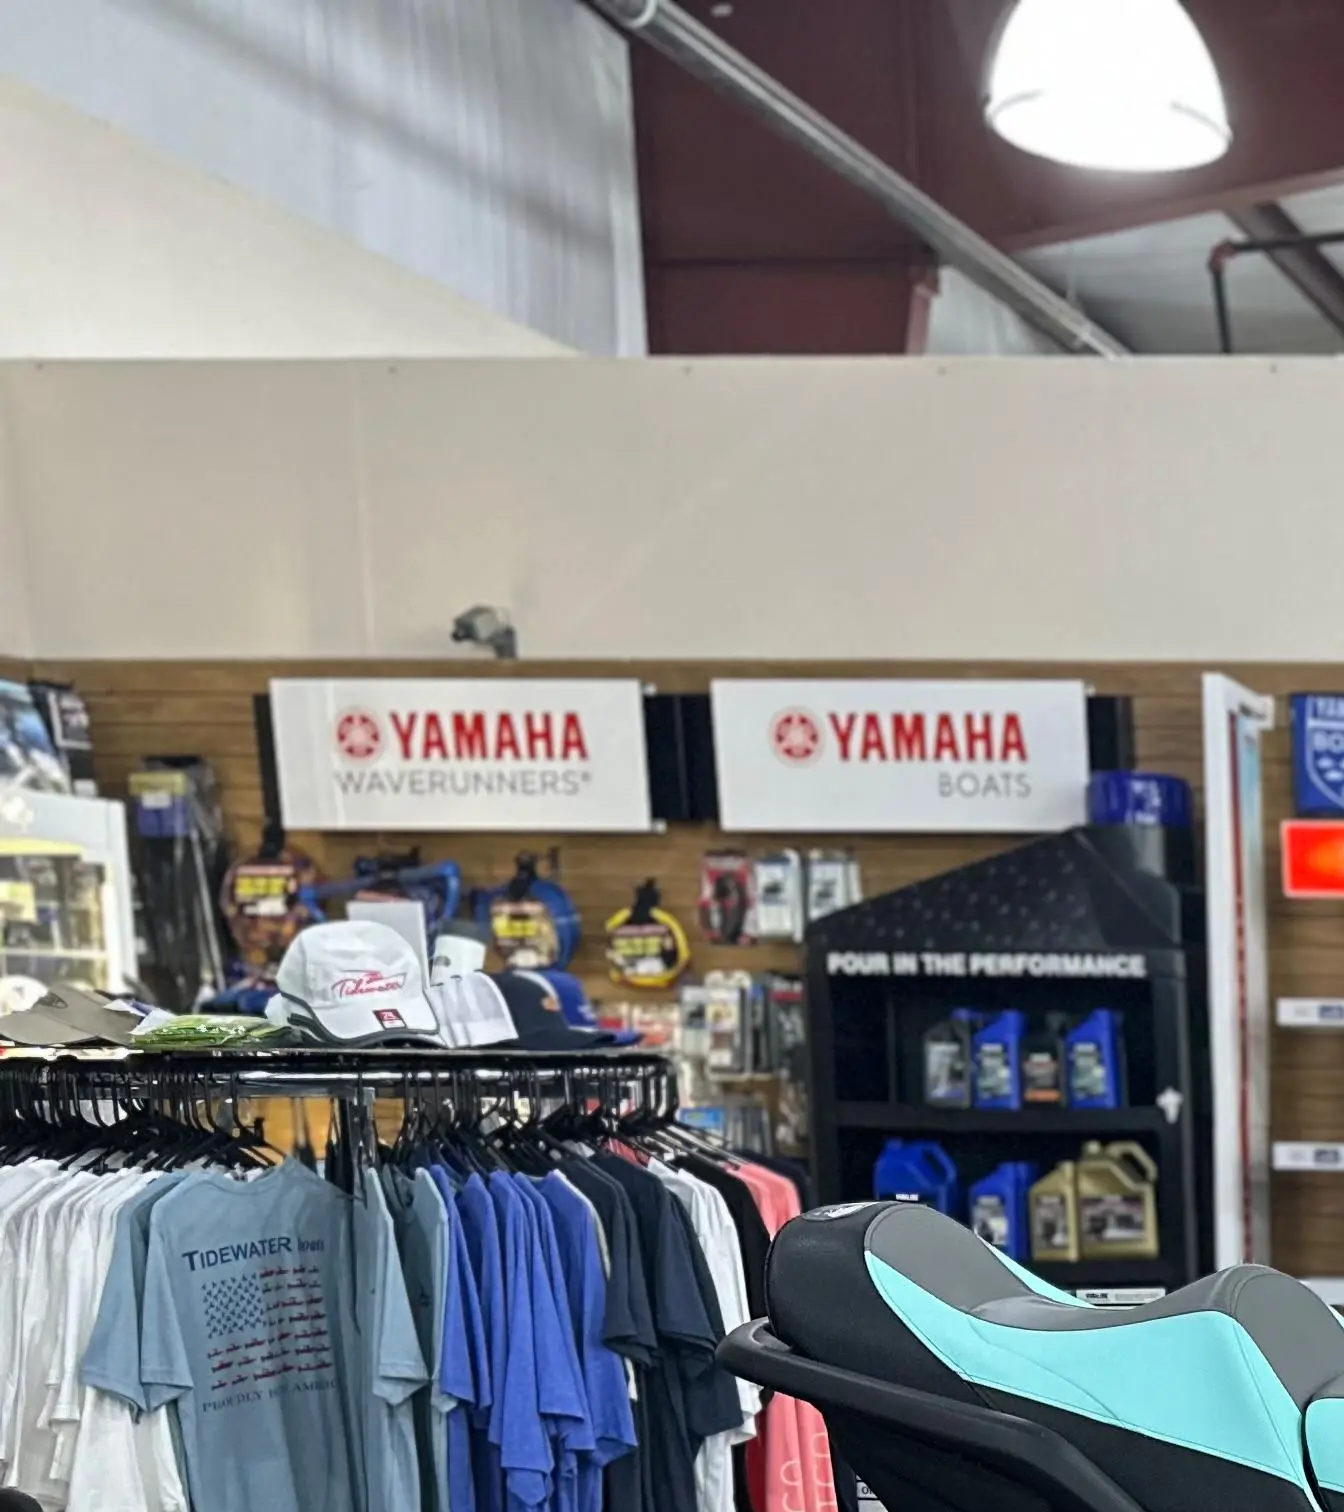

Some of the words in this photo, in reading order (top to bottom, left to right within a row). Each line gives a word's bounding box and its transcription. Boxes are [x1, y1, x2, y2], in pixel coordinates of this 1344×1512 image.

[389, 711, 590, 762] YAMAHA
[828, 712, 1028, 763] YAMAHA
[937, 771, 1032, 798] BOATS
[827, 952, 889, 976] POUR
[893, 952, 917, 976] IN
[921, 952, 966, 977] THE
[182, 1236, 293, 1271] TIDEWATER
